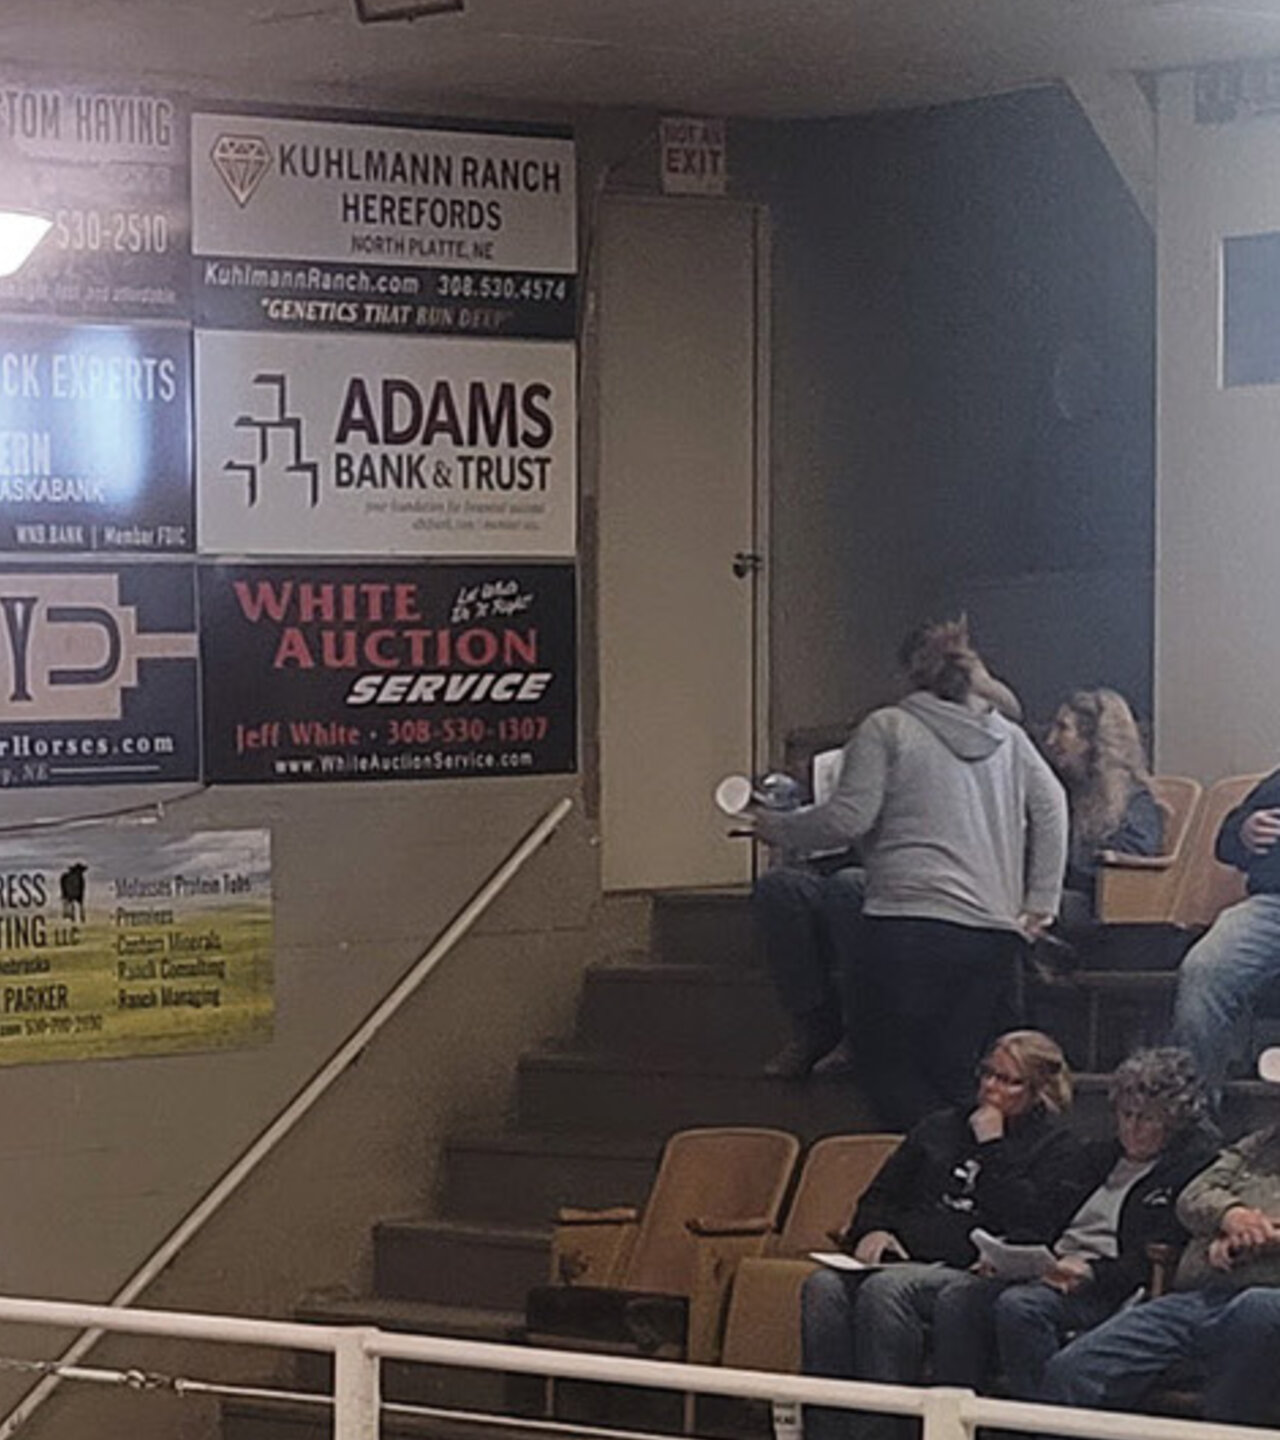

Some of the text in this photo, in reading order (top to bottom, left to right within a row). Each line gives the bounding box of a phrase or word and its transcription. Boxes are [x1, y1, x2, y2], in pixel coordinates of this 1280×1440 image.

[74, 94, 173, 147] HAYING
[278, 144, 562, 194] KUHLMANN RANCH
[667, 148, 721, 174] EXIT
[342, 192, 503, 231] HEREFORDS
[351, 235, 495, 260] NORTH PLATTE, NE
[204, 262, 419, 293] KuhlmannRanch.com
[437, 274, 566, 300] 308.530.4574
[364, 302, 412, 323] THAT
[416, 305, 454, 326] RUN
[51, 353, 177, 402] EXPERTS
[335, 376, 554, 449] ADAMS
[335, 451, 552, 491] BANK & TRUST
[104, 526, 154, 546] Member
[157, 526, 186, 546] FDIC
[234, 580, 421, 623] WHITE
[273, 627, 537, 670] AUCTION
[346, 673, 553, 705] SERVICE
[237, 717, 549, 754] Jeff White 308-530-1307
[274, 750, 534, 773] www.WhiteAuctionService.com
[54, 926, 82, 946] LLC
[3, 983, 69, 1014] PARKER
